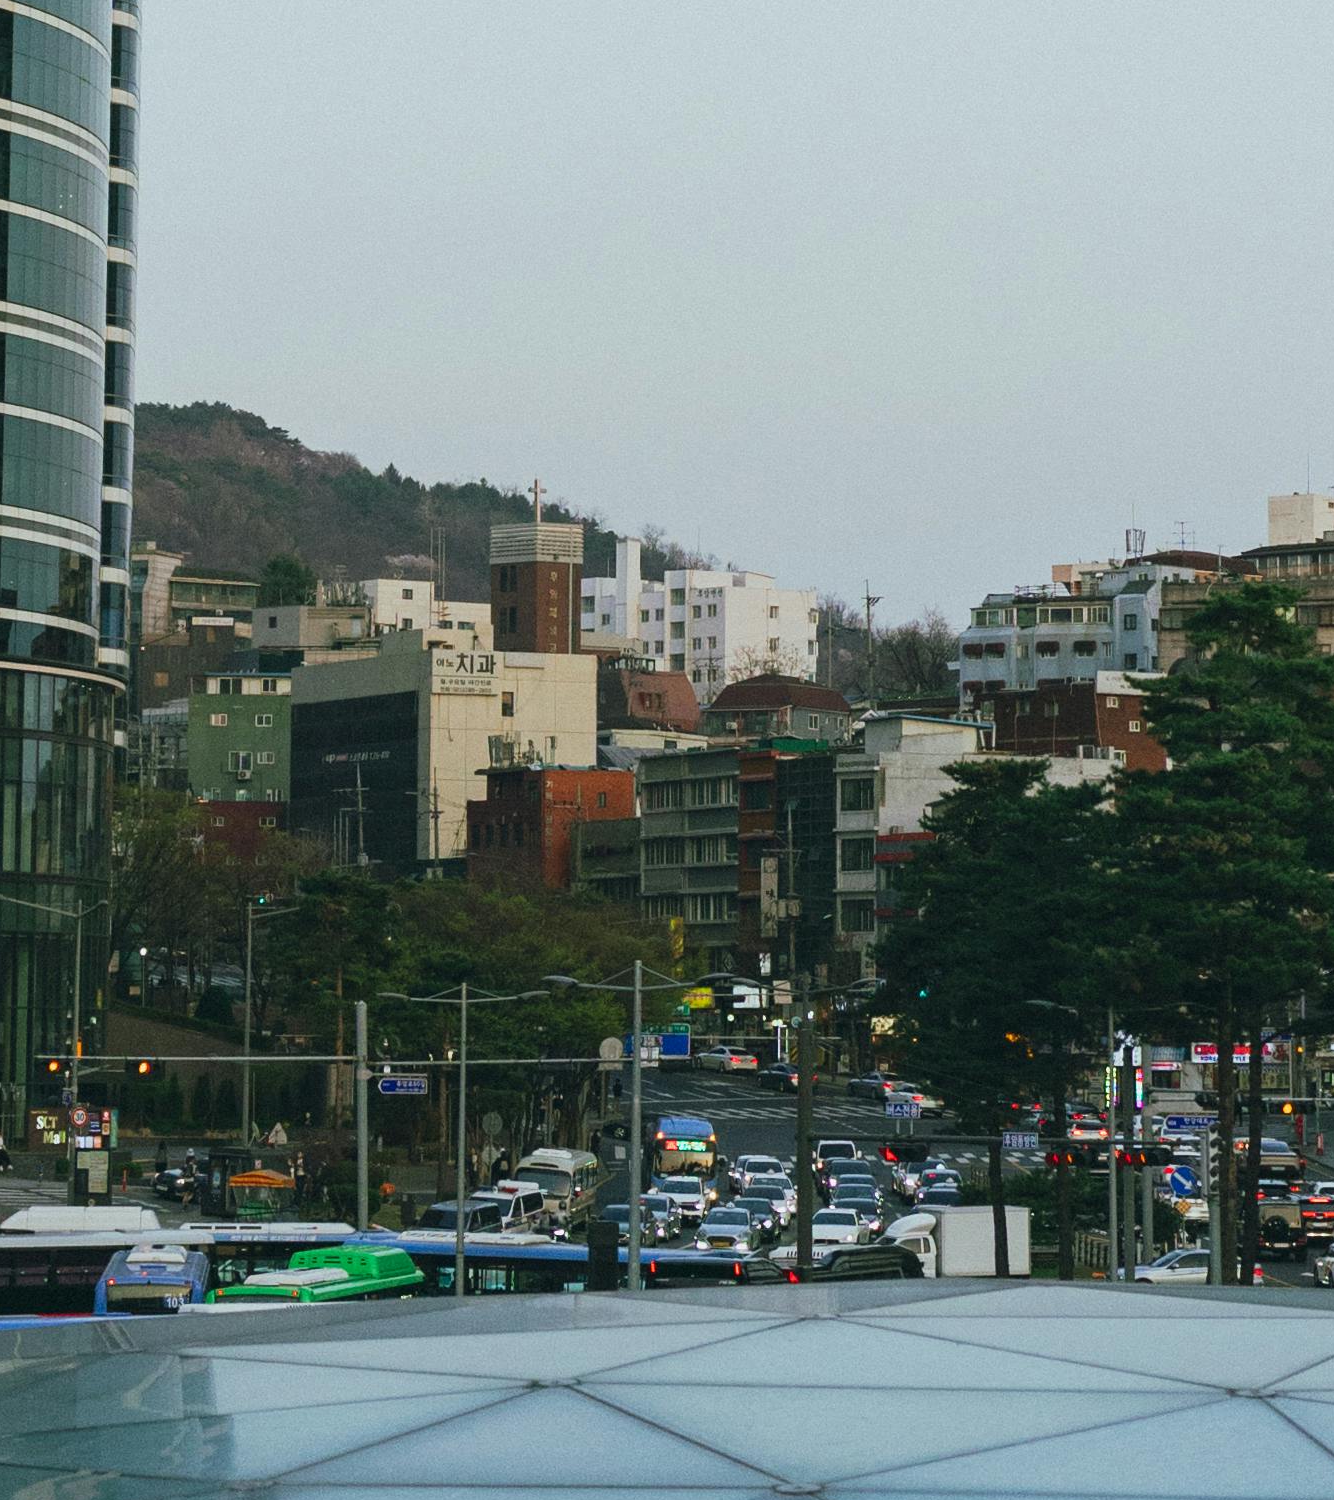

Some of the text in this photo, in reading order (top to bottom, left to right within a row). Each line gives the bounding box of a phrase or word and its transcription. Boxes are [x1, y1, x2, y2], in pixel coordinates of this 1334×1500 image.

[455, 652, 497, 675] 치과
[36, 1116, 58, 1130] SCT
[43, 1130, 66, 1145] Mall
[166, 1296, 185, 1309] 103
